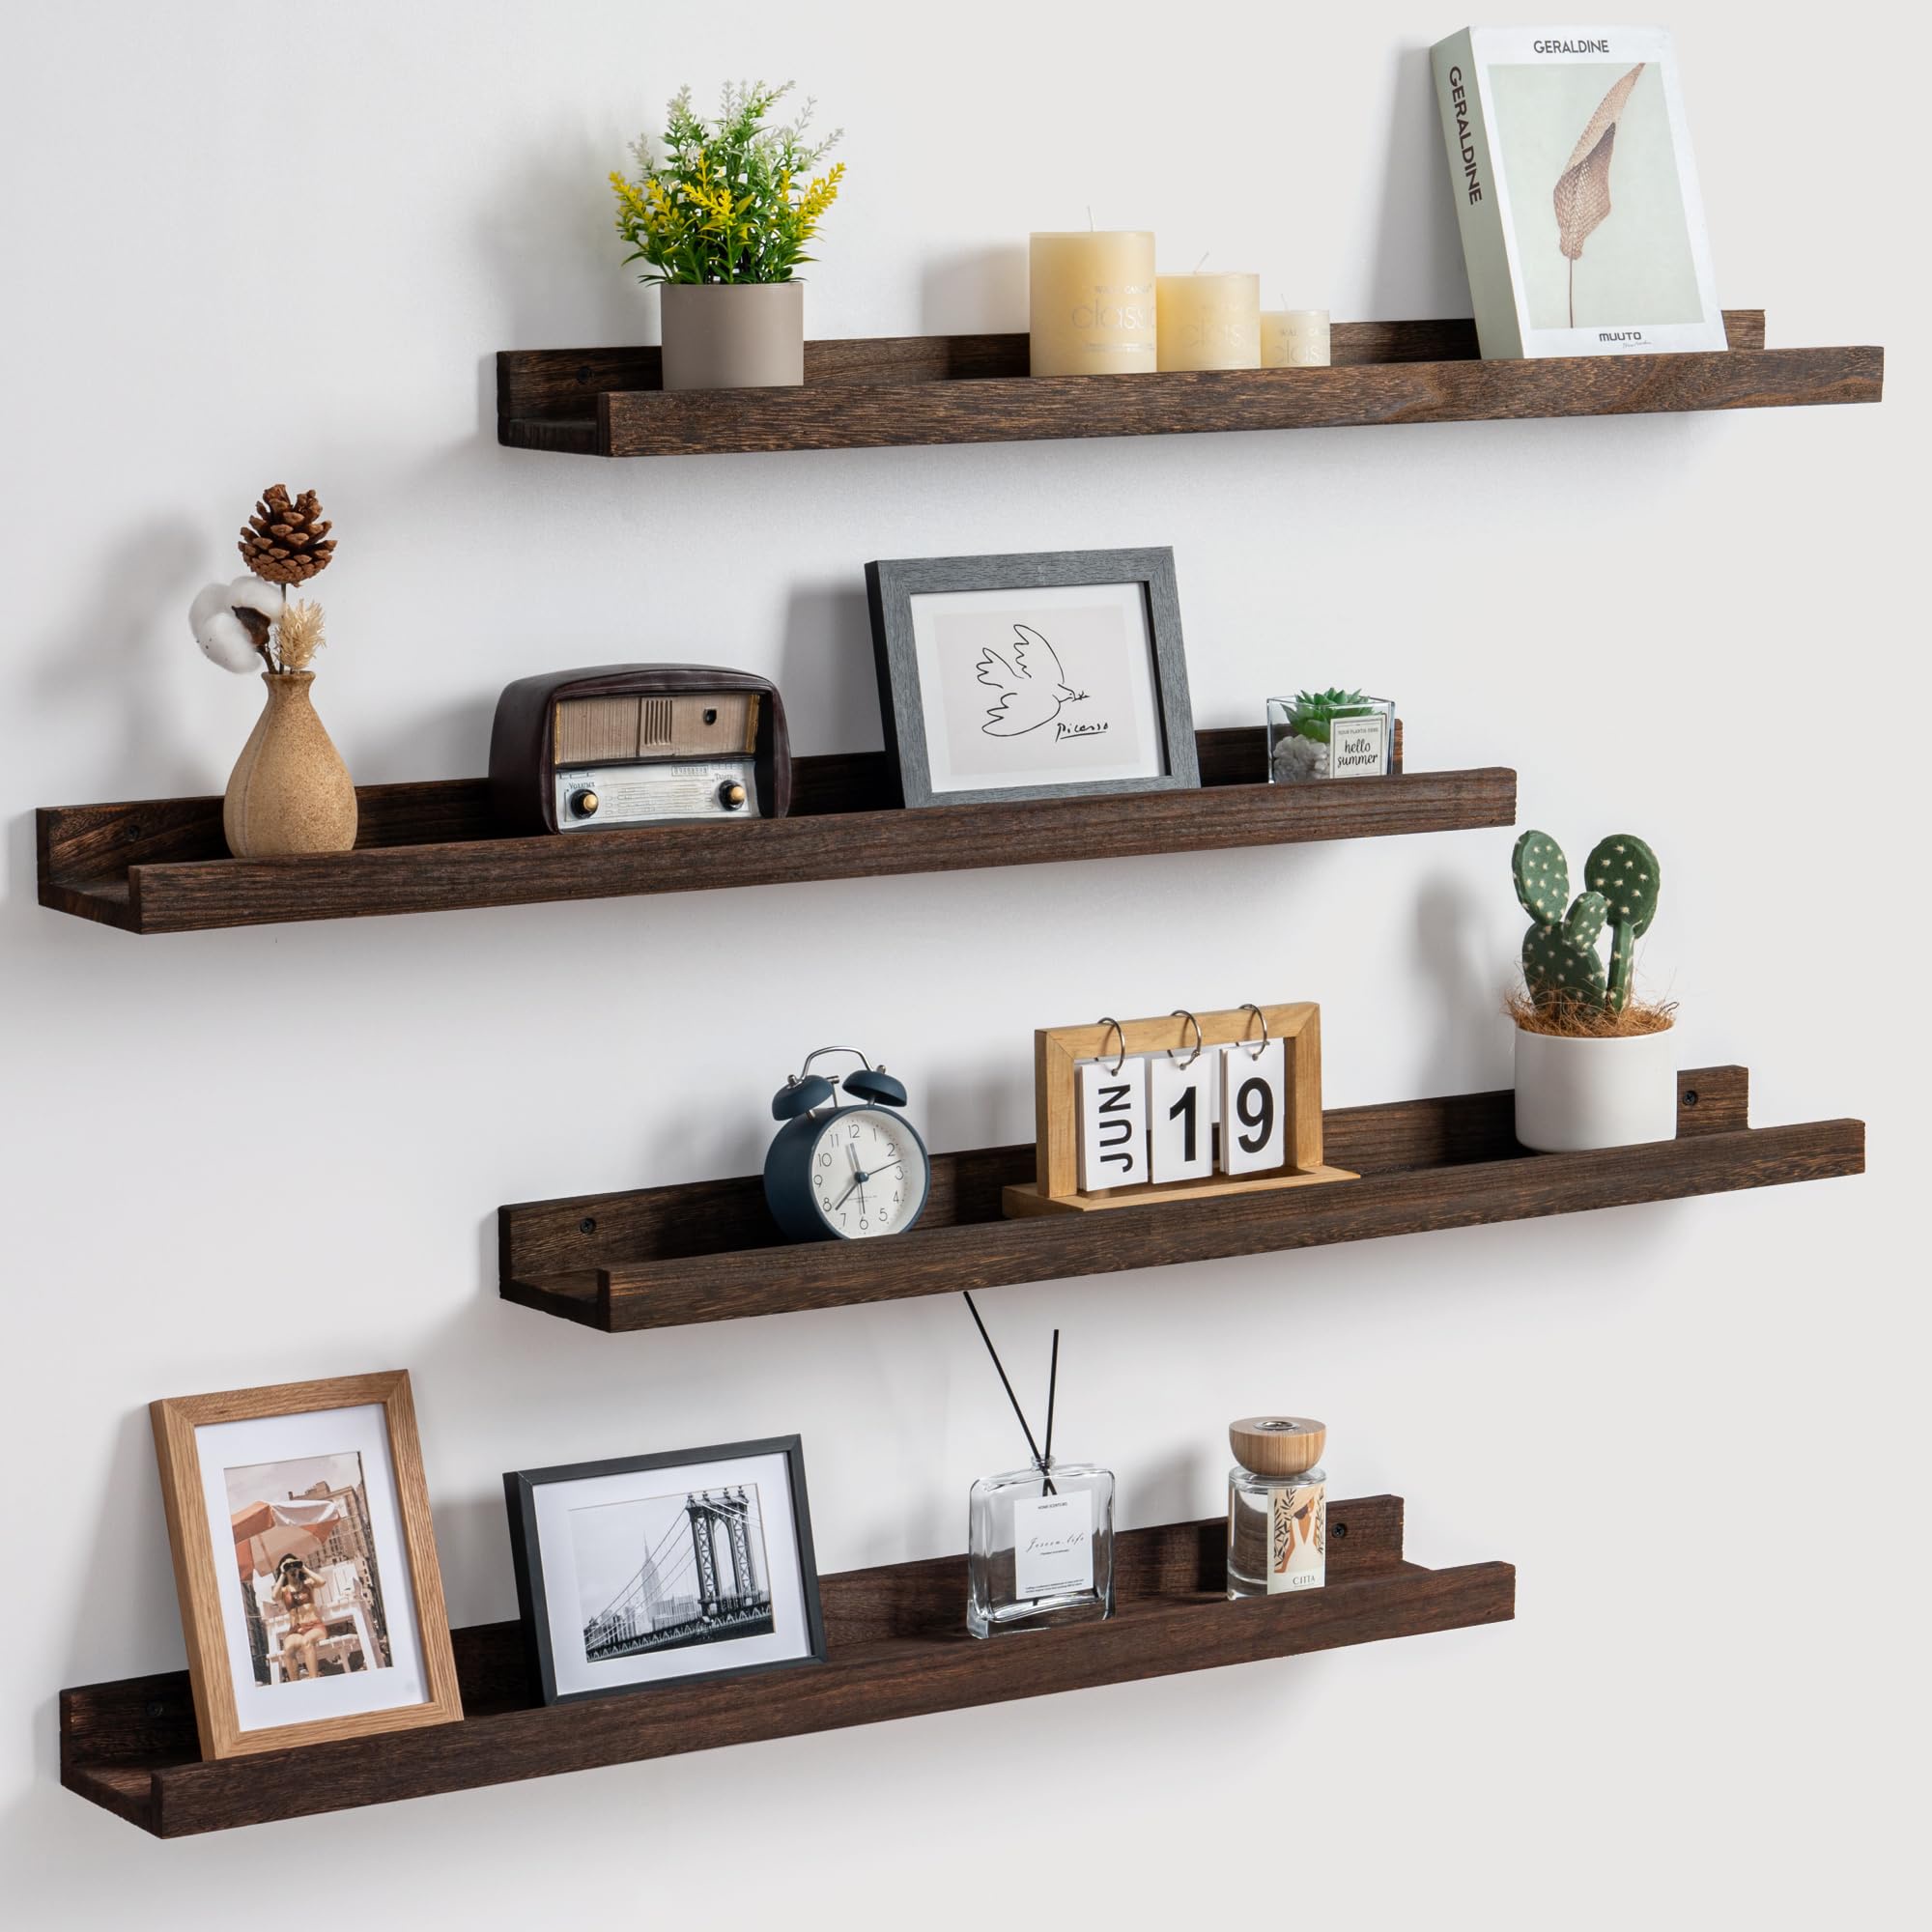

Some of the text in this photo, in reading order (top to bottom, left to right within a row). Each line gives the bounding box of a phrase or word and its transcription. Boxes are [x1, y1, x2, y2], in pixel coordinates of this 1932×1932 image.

[1533, 40, 1610, 54] GERALDINE
[1449, 66, 1483, 206] GERALDINE
[1599, 331, 1642, 342] MUUTO
[1345, 738, 1371, 753] hello
[1337, 753, 1378, 769] summer
[848, 1124, 860, 1138] 12
[1098, 1077, 1273, 1173] JUN 1 9
[830, 1134, 839, 1148] 11
[872, 1127, 877, 1142] 1
[887, 1143, 896, 1156] 2
[818, 1153, 832, 1167] 10
[895, 1166, 904, 1179] 3
[813, 1175, 823, 1187] 9
[893, 1190, 899, 1203] 4
[823, 1198, 832, 1211] 8
[840, 1213, 846, 1226] 7
[878, 1208, 888, 1221] 5
[860, 1215, 868, 1230] 6
